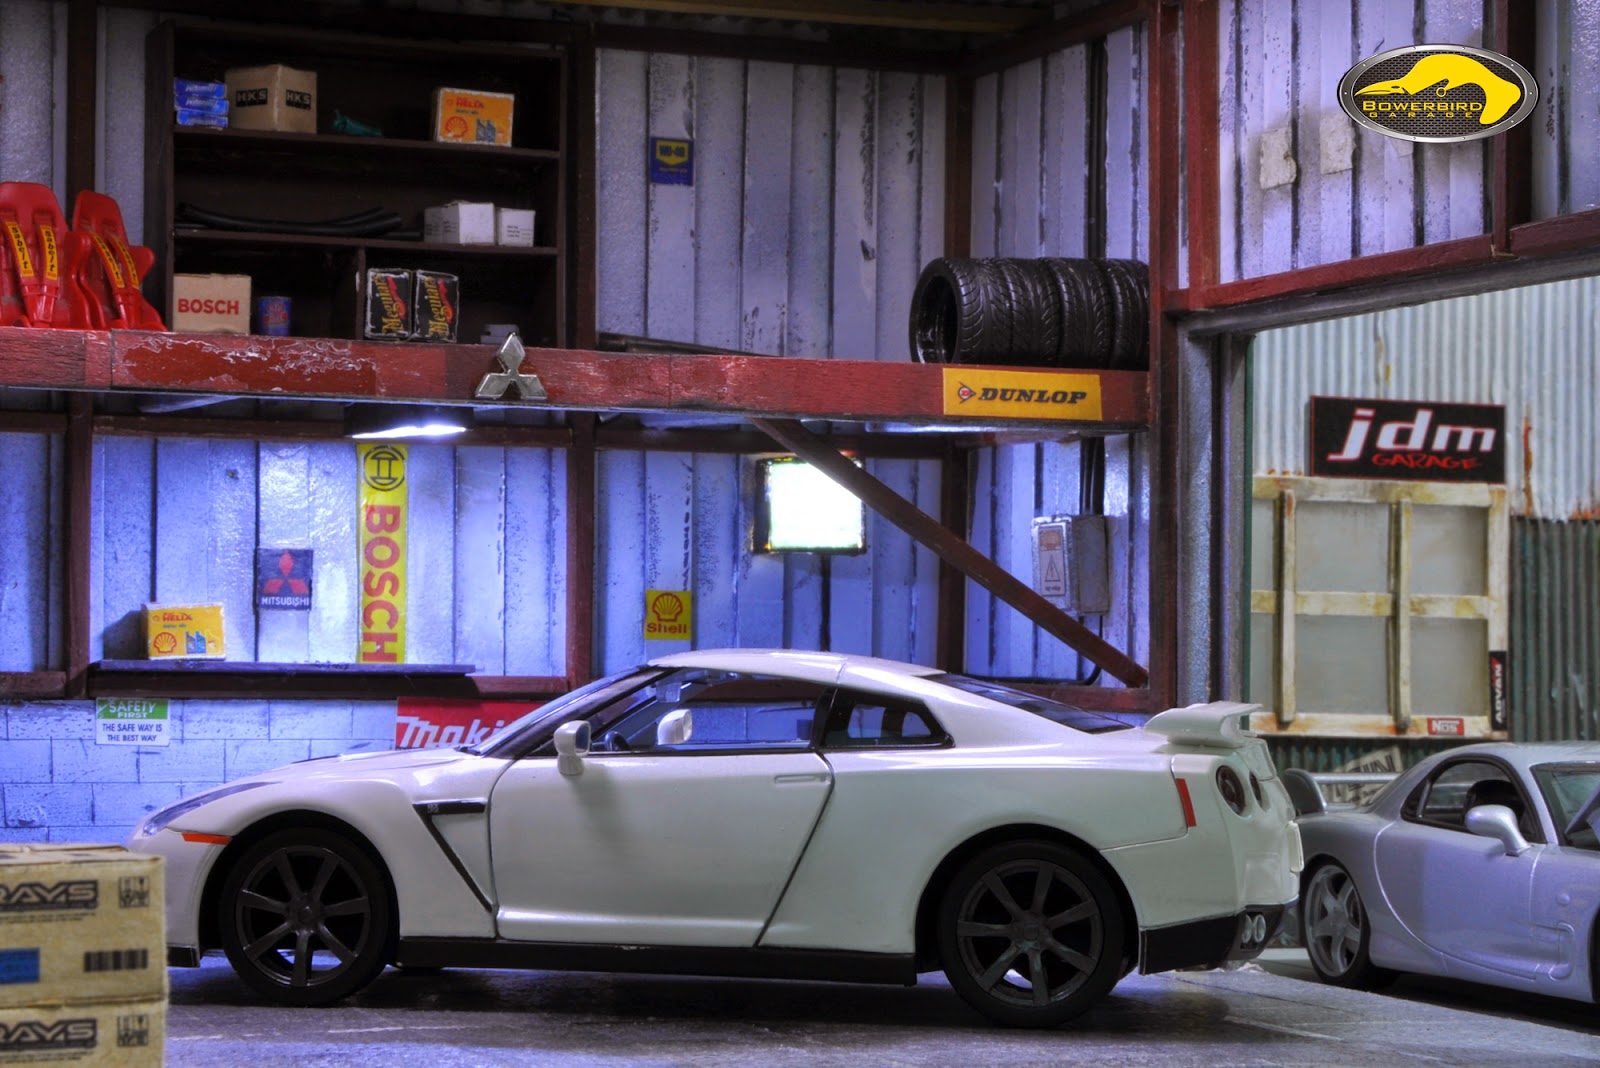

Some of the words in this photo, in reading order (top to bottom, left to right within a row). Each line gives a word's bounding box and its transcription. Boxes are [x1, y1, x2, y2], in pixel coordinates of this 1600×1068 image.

[237, 89, 268, 101] HKS
[286, 91, 310, 102] HKS
[177, 298, 240, 315] BOSCH
[979, 387, 1087, 404] DUNLOP
[1326, 407, 1497, 461] jdm
[1371, 452, 1483, 470] GARAGE
[362, 504, 401, 663] BOSCH
[261, 596, 310, 606] MITSUBISHI
[162, 613, 192, 621] HELIX
[646, 622, 688, 634] Shell
[1494, 663, 1503, 724] ADVAN
[109, 700, 157, 713] SAFETY
[117, 711, 149, 719] FIRST
[102, 723, 116, 732] THE
[117, 723, 135, 732] SAFE
[137, 723, 154, 732] WAY
[155, 723, 162, 732] IS
[107, 734, 119, 742] THE
[122, 734, 139, 742] BEST
[140, 734, 157, 742] WAY
